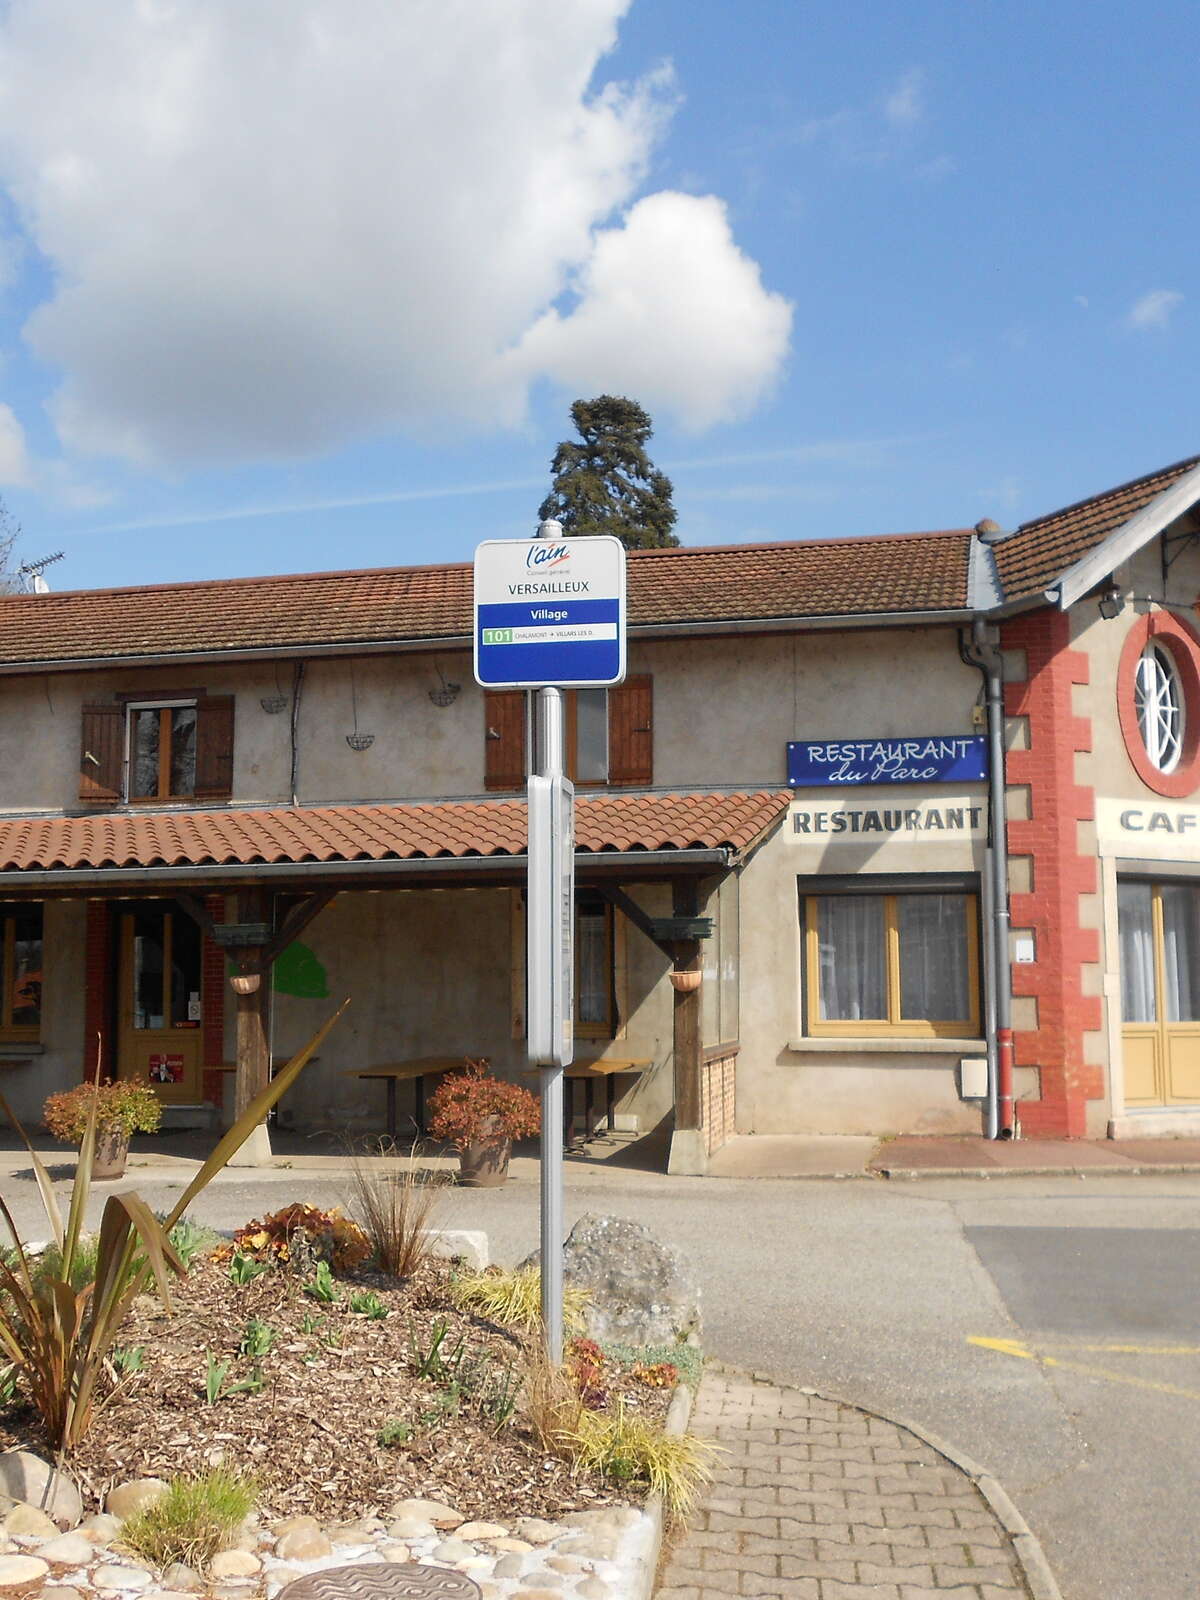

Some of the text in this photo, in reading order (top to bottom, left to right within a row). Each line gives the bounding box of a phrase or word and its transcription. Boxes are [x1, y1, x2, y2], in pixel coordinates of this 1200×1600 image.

[508, 581, 590, 595] VERSAILLEUX
[530, 608, 568, 621] Village
[487, 630, 512, 642] 101
[807, 740, 974, 763] RESTAURANT
[828, 757, 938, 781] du Parc
[793, 807, 982, 834] RESTAURANT
